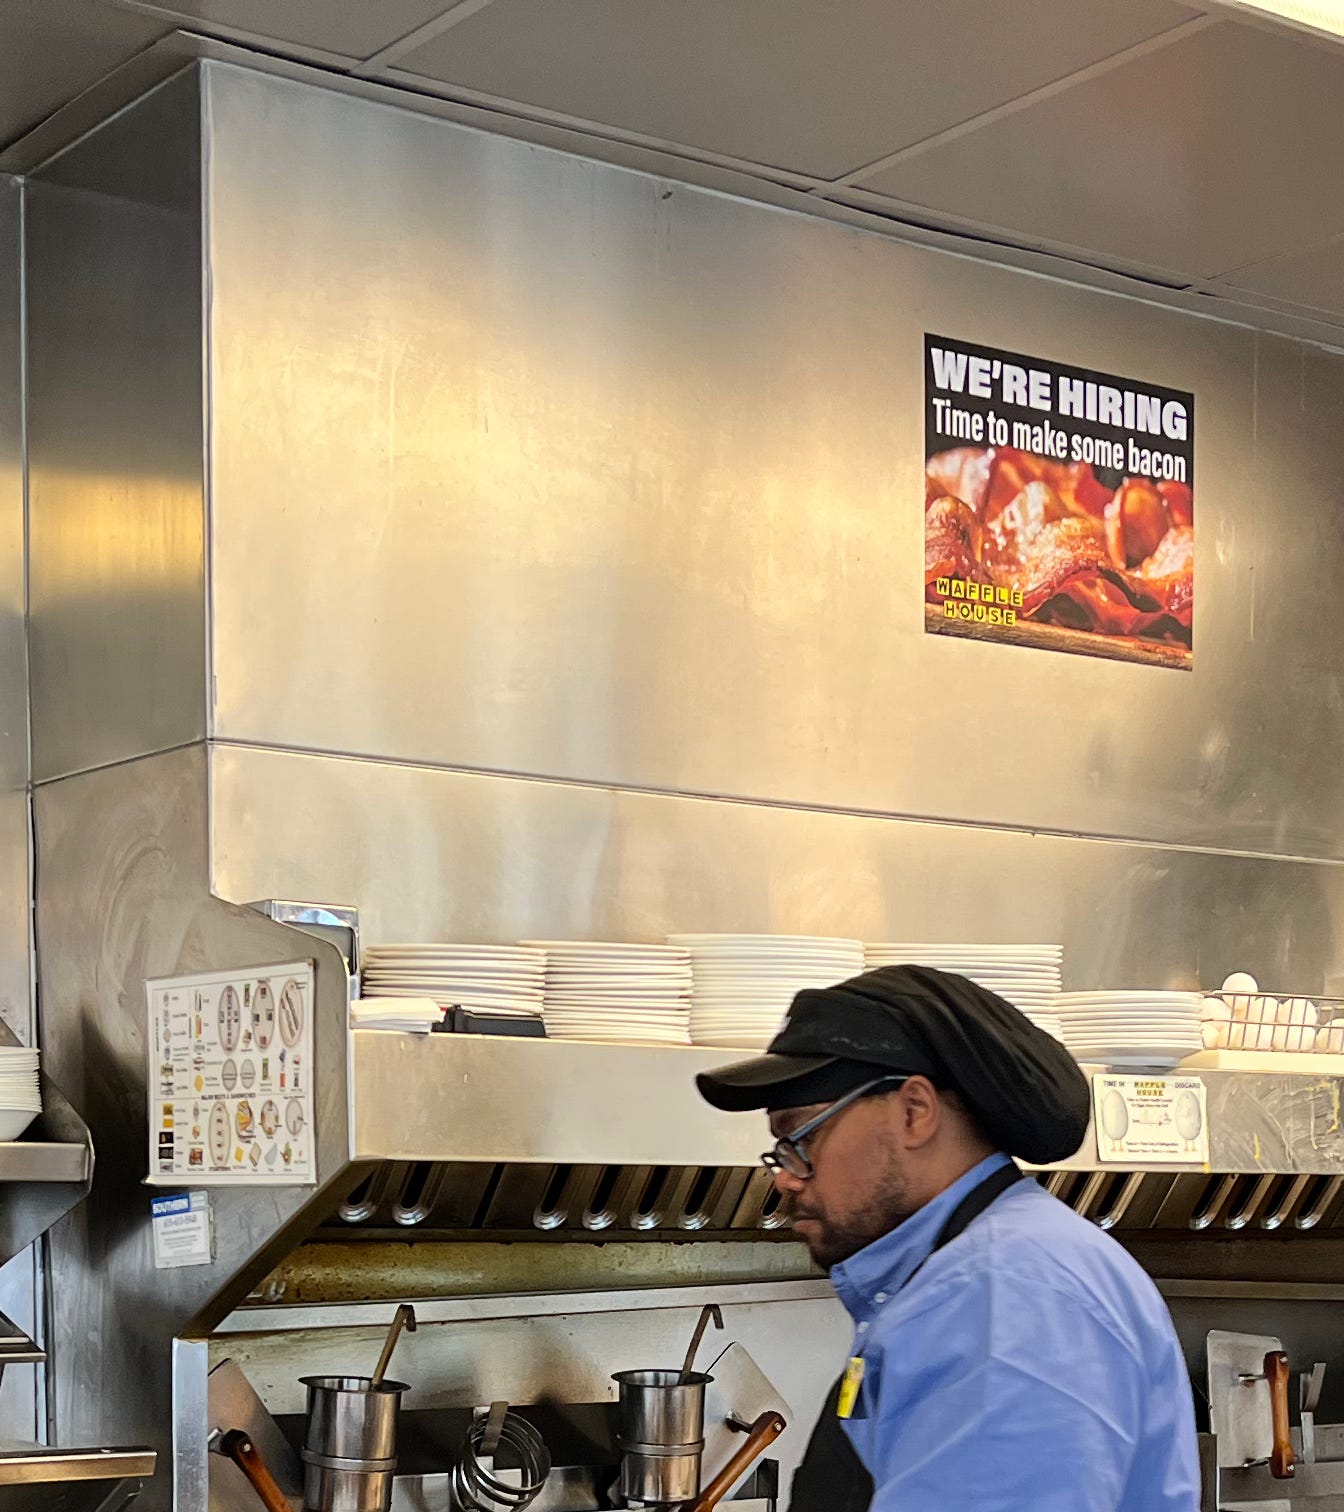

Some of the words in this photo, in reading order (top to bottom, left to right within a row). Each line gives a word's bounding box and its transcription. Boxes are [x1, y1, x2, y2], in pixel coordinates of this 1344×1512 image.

[929, 346, 1053, 413] WE'RE
[1057, 374, 1188, 442] HIRING
[931, 397, 985, 444] Time
[987, 410, 1009, 448] to
[1012, 419, 1068, 461] make
[1070, 437, 1125, 473] some
[1127, 437, 1187, 484] bacon
[935, 576, 1023, 608] WAFFLE
[943, 600, 1017, 627] HOUSE
